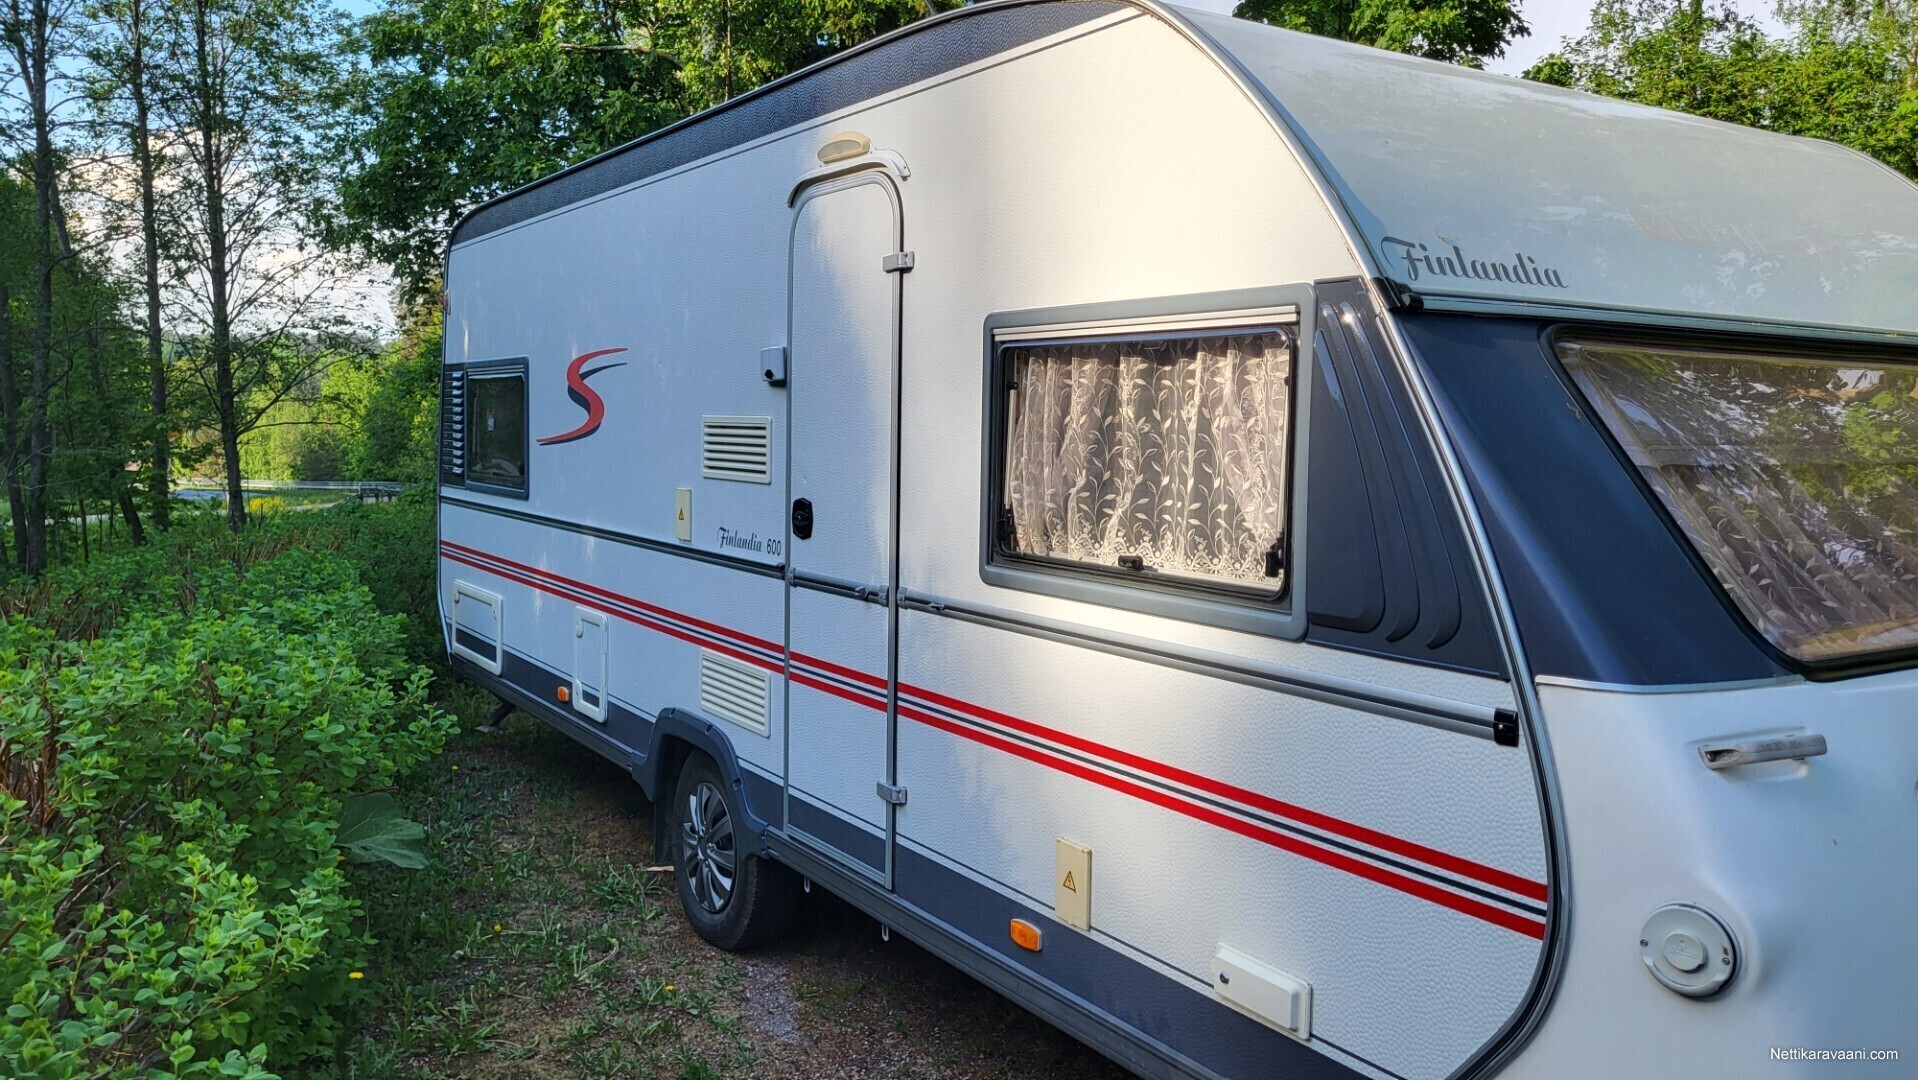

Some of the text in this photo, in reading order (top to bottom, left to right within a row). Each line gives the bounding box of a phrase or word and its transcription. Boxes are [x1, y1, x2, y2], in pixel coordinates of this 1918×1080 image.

[1381, 236, 1569, 289] Finlandia
[536, 347, 628, 446] S
[717, 526, 782, 556] Finlandia 600
